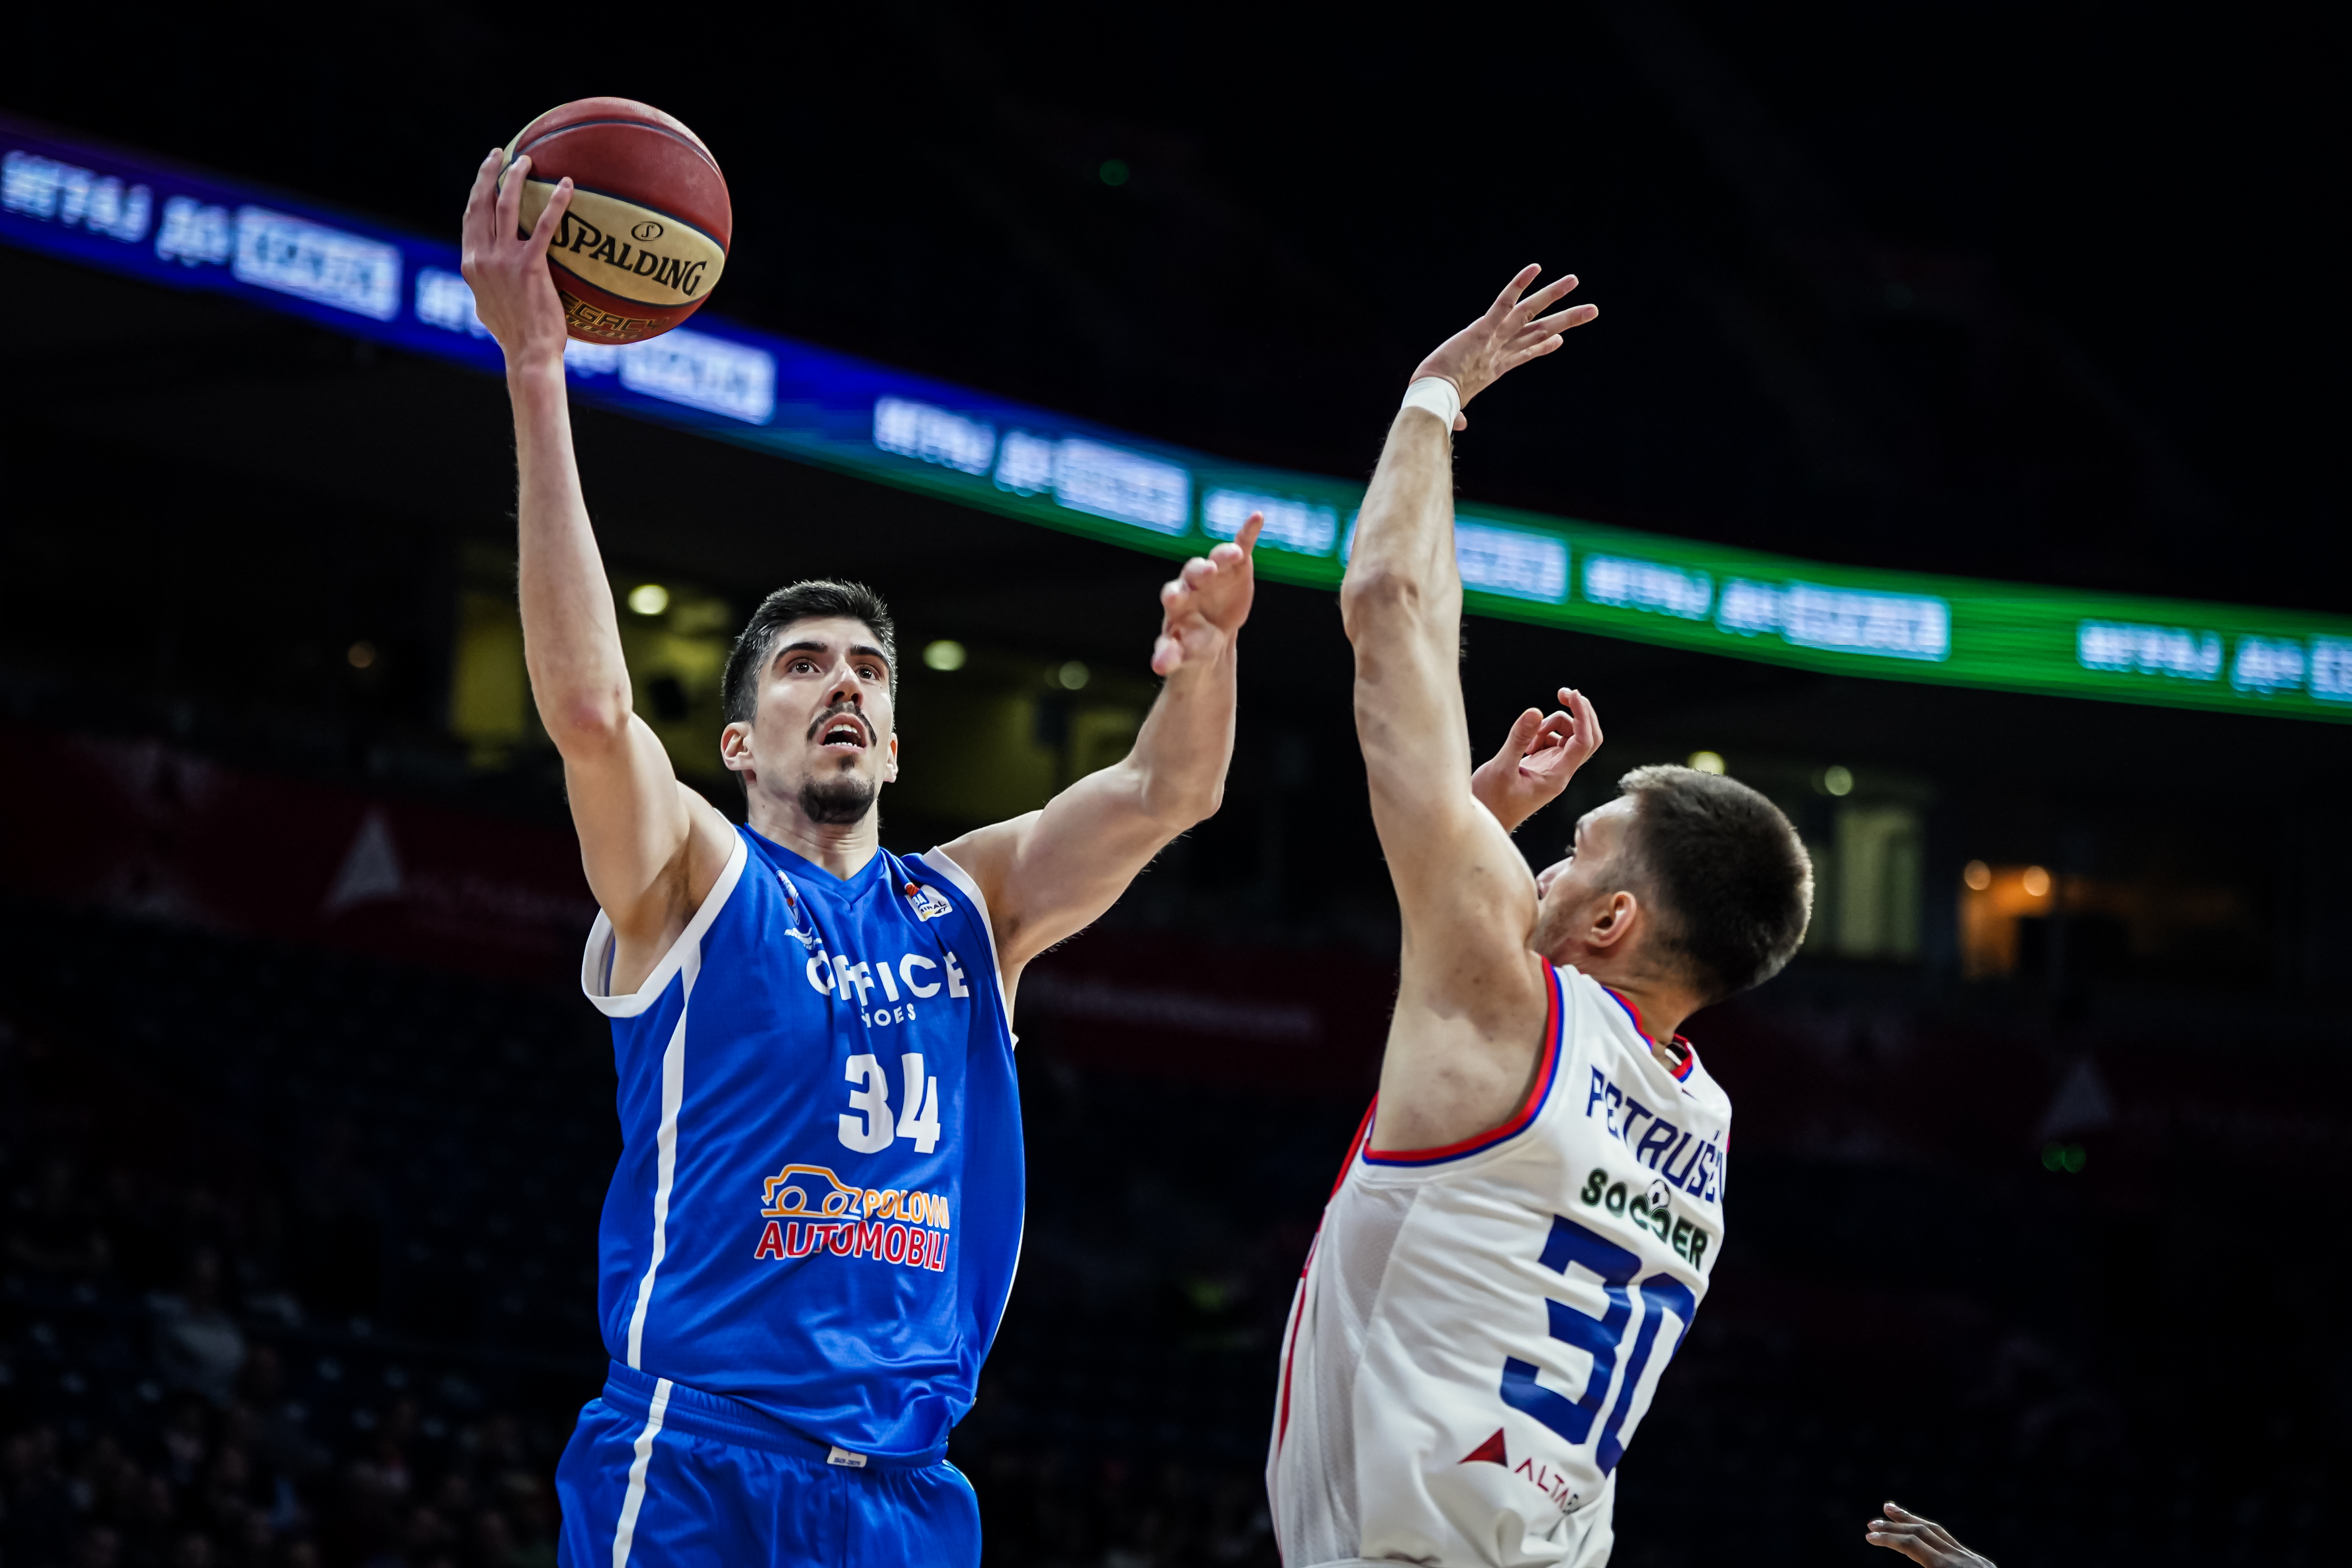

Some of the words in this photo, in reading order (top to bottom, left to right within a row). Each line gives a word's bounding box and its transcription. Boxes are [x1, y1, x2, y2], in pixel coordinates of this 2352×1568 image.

[551, 210, 707, 296] SPALDING
[559, 289, 670, 333] EGACY
[806, 950, 969, 1007] OFFICE
[838, 1052, 941, 1154] 34
[754, 1220, 950, 1272] AUTOMOBILI
[1499, 1214, 1696, 1480] 30
